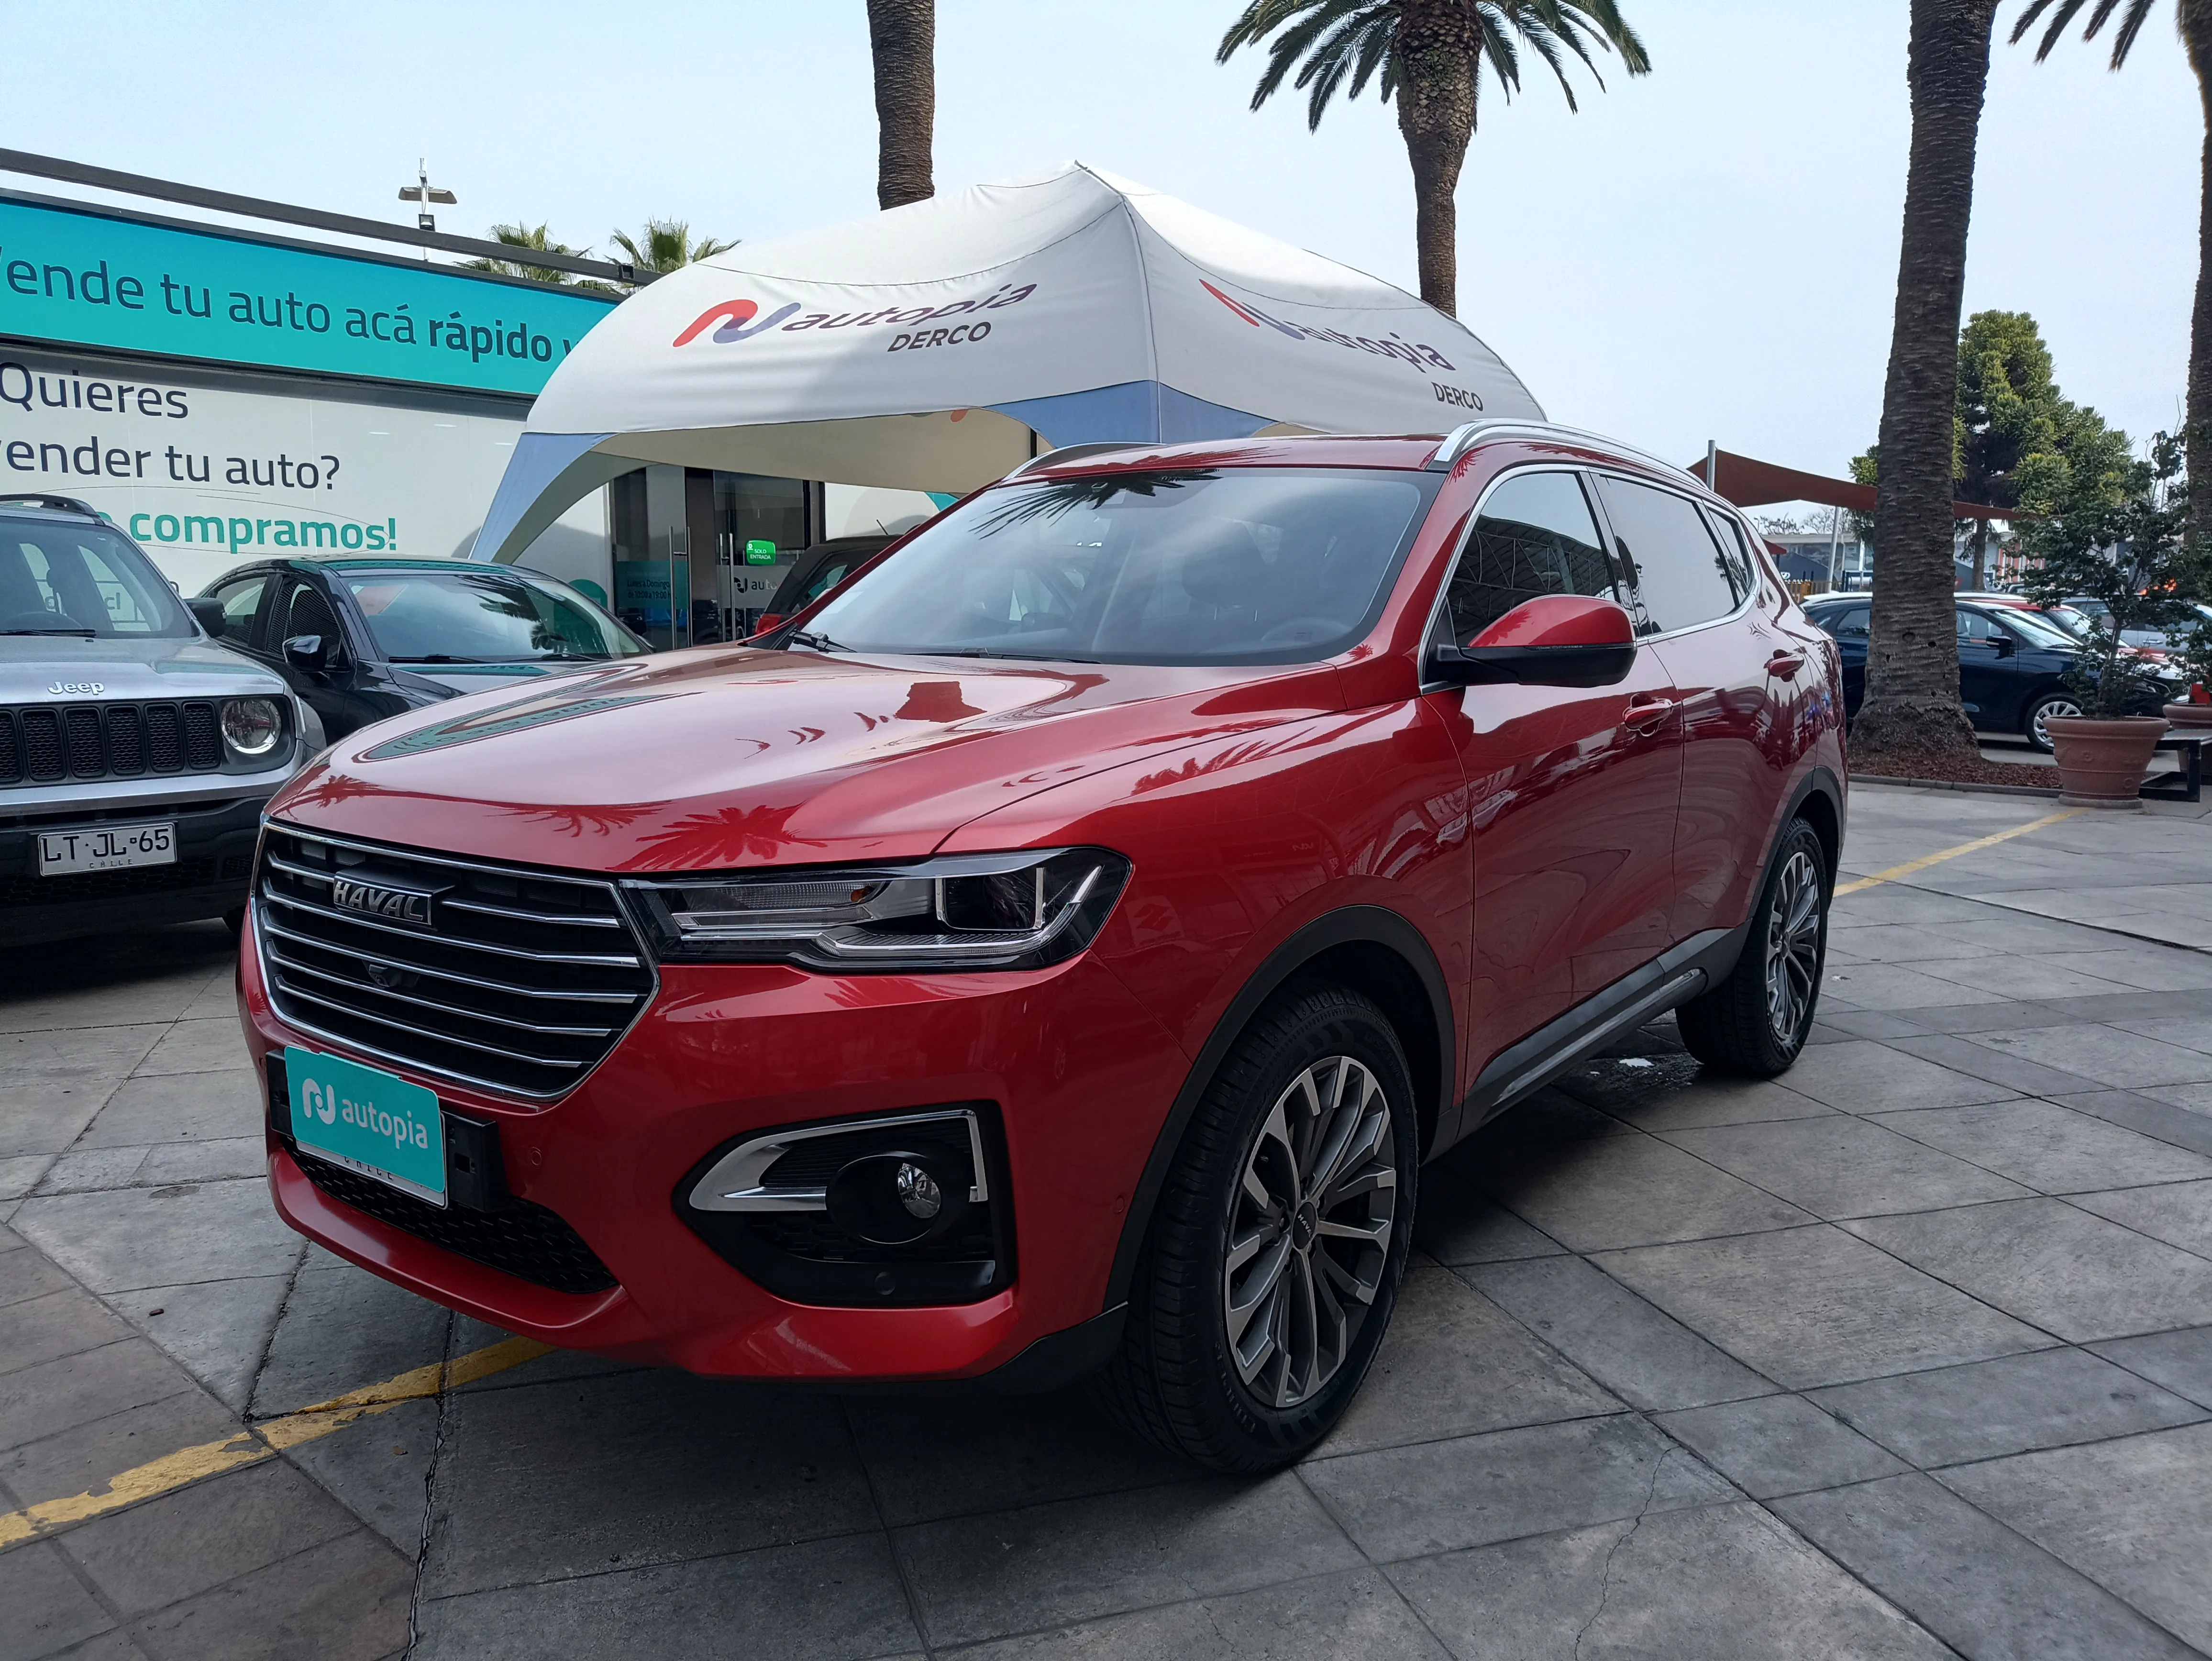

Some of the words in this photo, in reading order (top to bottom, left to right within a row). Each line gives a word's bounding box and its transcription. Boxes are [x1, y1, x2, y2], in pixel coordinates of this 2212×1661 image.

[0, 246, 144, 310] ende
[159, 274, 211, 318] tu
[228, 292, 331, 333] auto
[345, 303, 416, 345] acá
[429, 311, 553, 363] rápido
[782, 284, 1037, 331] autopia
[887, 321, 992, 352] DERCO
[0, 362, 188, 419] Quieres
[1431, 381, 1484, 412] DERCO
[0, 436, 151, 478] ender
[166, 445, 210, 482] tu
[226, 454, 340, 490] auto?
[129, 512, 397, 554] compramos!
[751, 579, 778, 590] auto
[48, 681, 105, 695] Jeep
[333, 882, 423, 920] HAVAL
[342, 1099, 428, 1149] autopia
